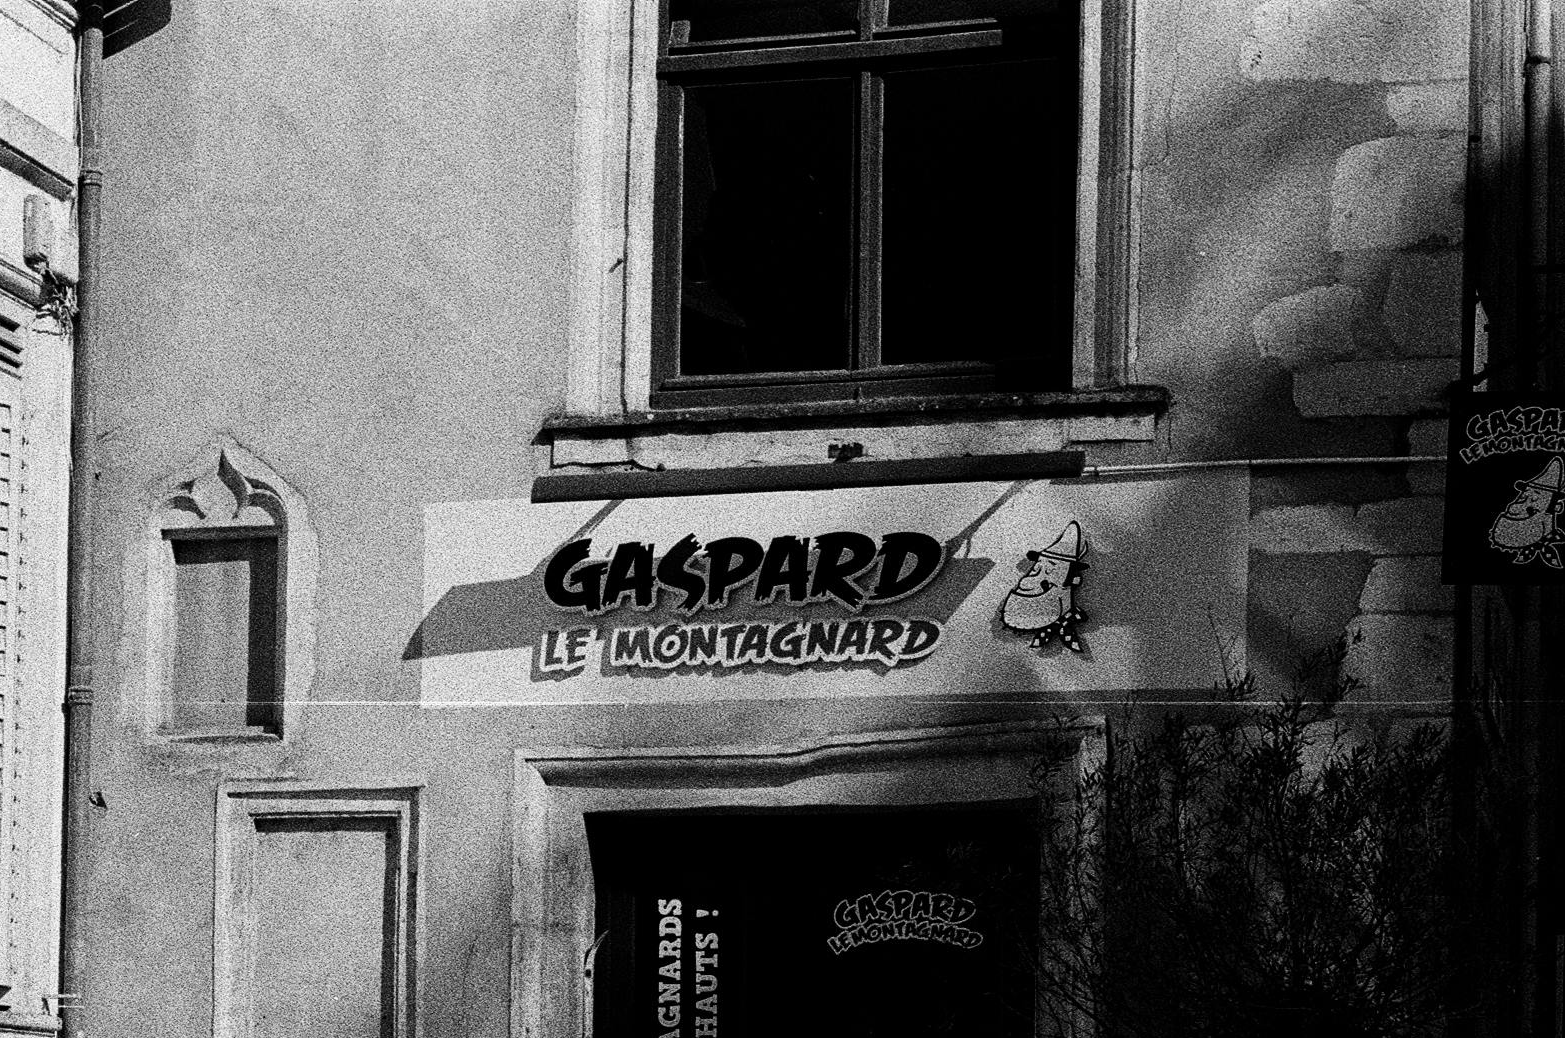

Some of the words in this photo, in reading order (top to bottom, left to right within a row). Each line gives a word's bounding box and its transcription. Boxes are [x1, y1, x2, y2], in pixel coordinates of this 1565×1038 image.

[1466, 405, 1565, 441] GASPA
[1459, 442, 1485, 464] LE
[543, 531, 943, 612] GASPARD
[540, 627, 595, 671] LE
[611, 620, 941, 668] MONTAGNARD
[834, 890, 977, 929] GASPARD
[827, 931, 853, 955] LE
[849, 920, 984, 949] MONTAGNARD
[695, 933, 719, 1038] HAUTS
